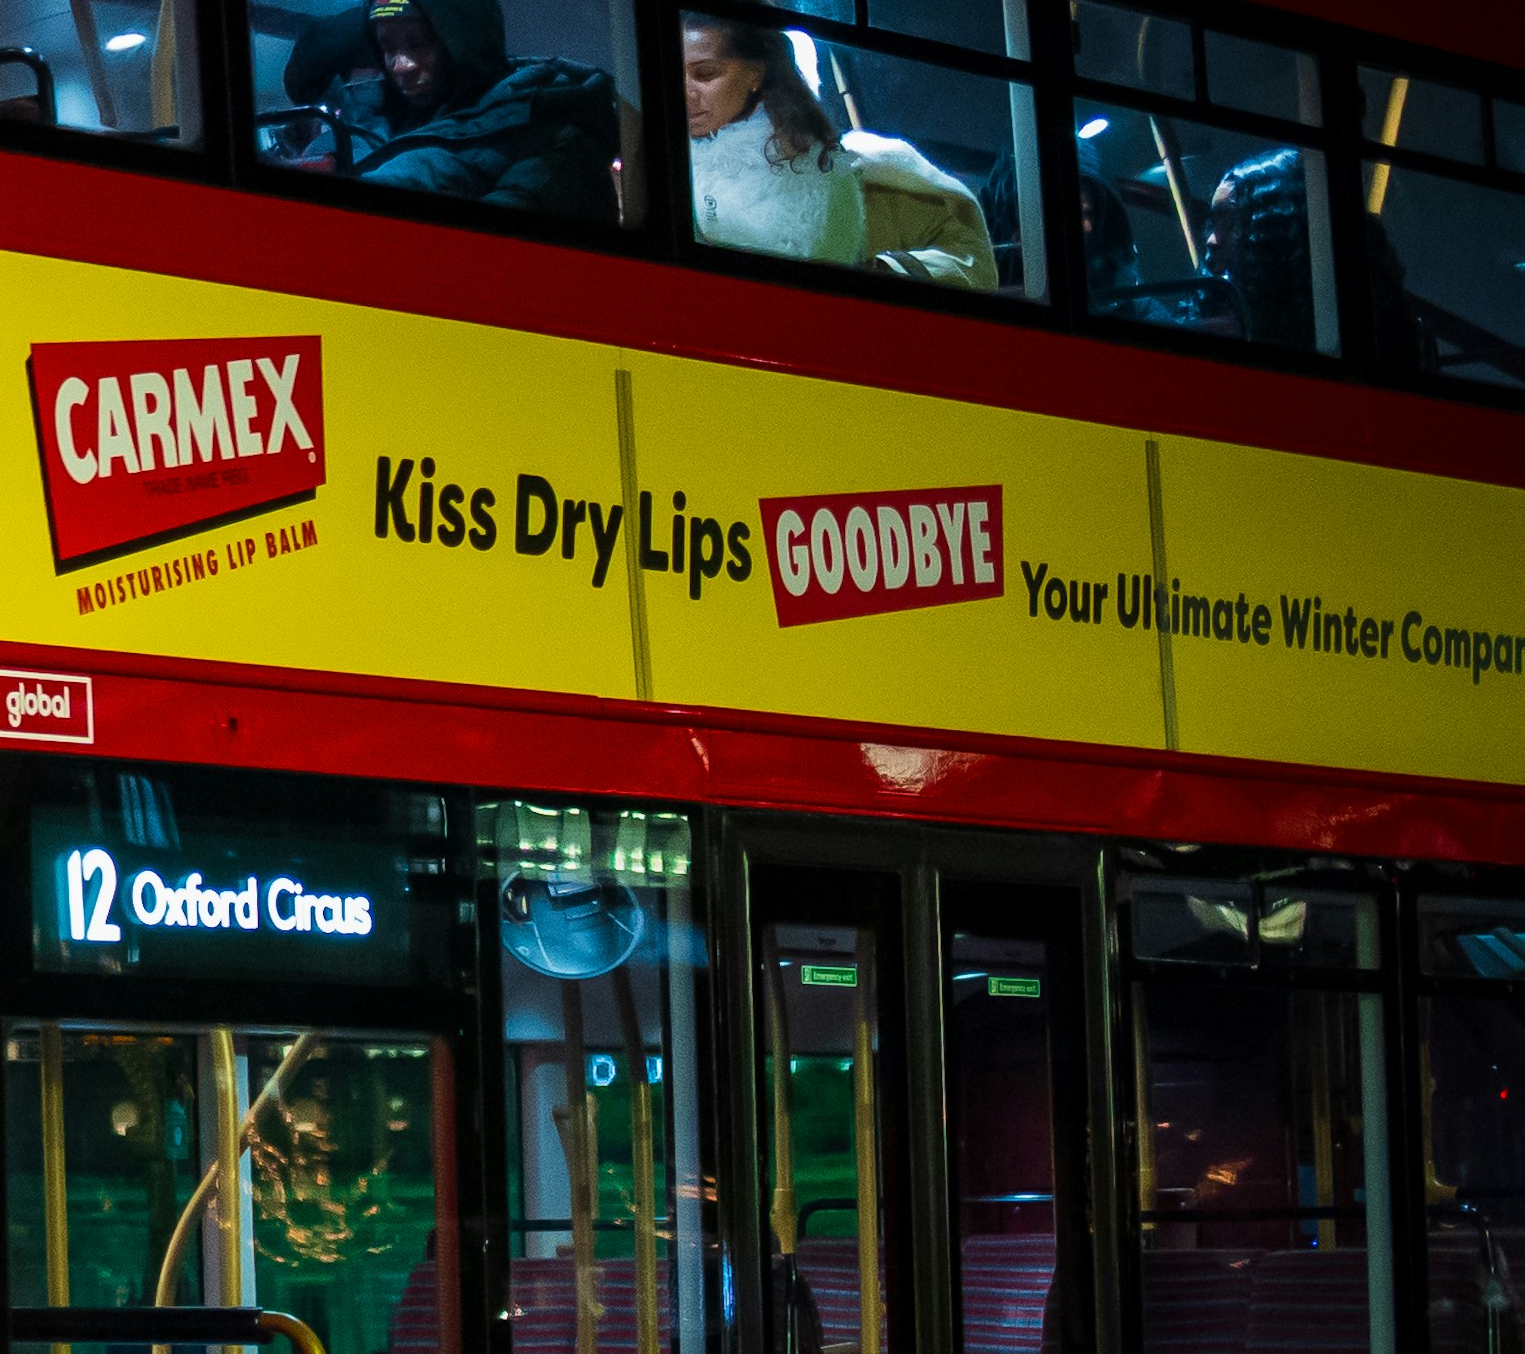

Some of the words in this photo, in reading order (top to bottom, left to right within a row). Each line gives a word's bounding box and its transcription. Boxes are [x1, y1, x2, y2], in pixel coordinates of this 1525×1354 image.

[55, 354, 314, 484] CARMEX
[77, 549, 218, 615] MOISTURISING
[226, 538, 256, 570] LIP
[265, 520, 318, 558] BALM
[374, 456, 498, 552] Kiss
[513, 473, 623, 589] Dry
[638, 490, 753, 600] Lips
[775, 500, 996, 597] GOODBYE
[1020, 561, 1108, 624] Your
[1117, 570, 1272, 647] Ultimate
[1279, 595, 1393, 660] Winter
[6, 682, 70, 727] global
[66, 847, 121, 942] 12
[132, 871, 258, 934] Oxford
[268, 876, 372, 936] Circus
